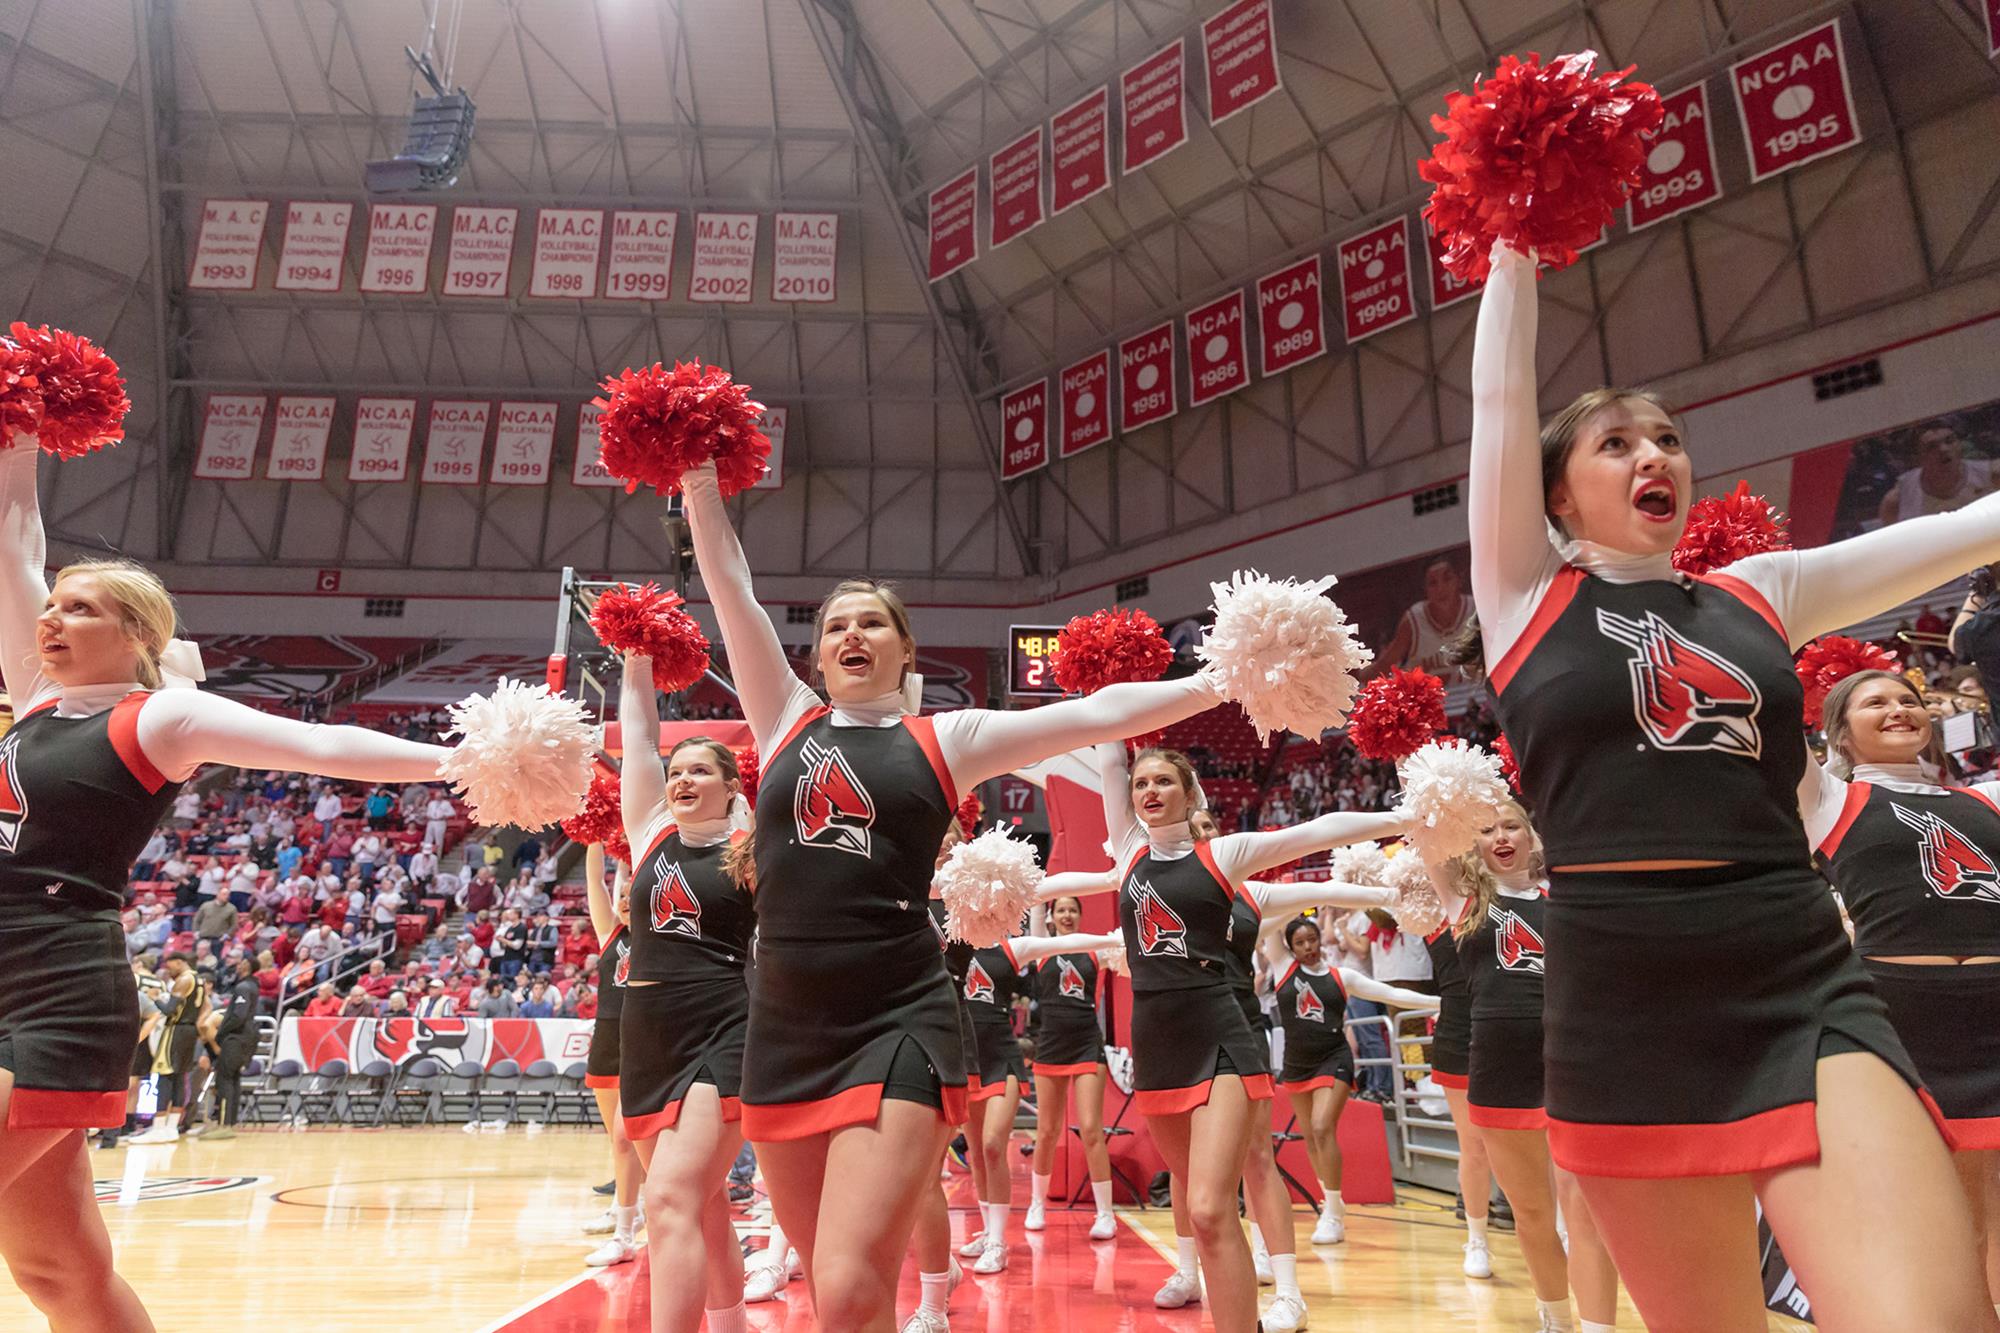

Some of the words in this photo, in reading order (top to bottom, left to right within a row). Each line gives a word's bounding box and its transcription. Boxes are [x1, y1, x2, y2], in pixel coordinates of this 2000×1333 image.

[1741, 42, 1834, 95] NCAA
[1764, 114, 1840, 157] 1995
[1639, 169, 1704, 208] 1993
[455, 214, 513, 234] M.A.C.
[541, 217, 598, 236] M.A.C.
[616, 218, 671, 238] M.A.C.
[699, 220, 753, 240] M.A.C.
[779, 220, 834, 239] M.A.C.
[1343, 232, 1405, 269] NCAA
[202, 265, 247, 279] 1993
[287, 266, 333, 281] 1994
[377, 269, 414, 285] 1996
[452, 271, 502, 288] 1997
[546, 274, 583, 290] 1998
[611, 273, 666, 292] 1999
[694, 277, 748, 294] 2002
[778, 277, 830, 294] 2010
[1260, 271, 1318, 307] NCAA
[1356, 295, 1401, 325] 1990
[1189, 305, 1241, 339] NCAA
[1122, 337, 1170, 368] NCAA
[1272, 329, 1314, 358] 1989
[1064, 363, 1105, 392] NCAA
[1199, 361, 1238, 389] 1986
[209, 404, 262, 417] NCAA
[280, 405, 331, 419] NCAA
[1006, 393, 1041, 420] NAIA
[1131, 391, 1167, 415] 1981
[360, 407, 411, 420] NCAA
[432, 409, 485, 422] NCAA
[502, 411, 553, 424] NCAA
[207, 456, 247, 470] 1992
[1008, 442, 1041, 466] 1957
[278, 458, 316, 471] 1993
[359, 459, 399, 472] 1994
[433, 462, 473, 475] 1995
[501, 463, 542, 475] 1999
[322, 576, 335, 590] C
[1004, 788, 1030, 810] 17
